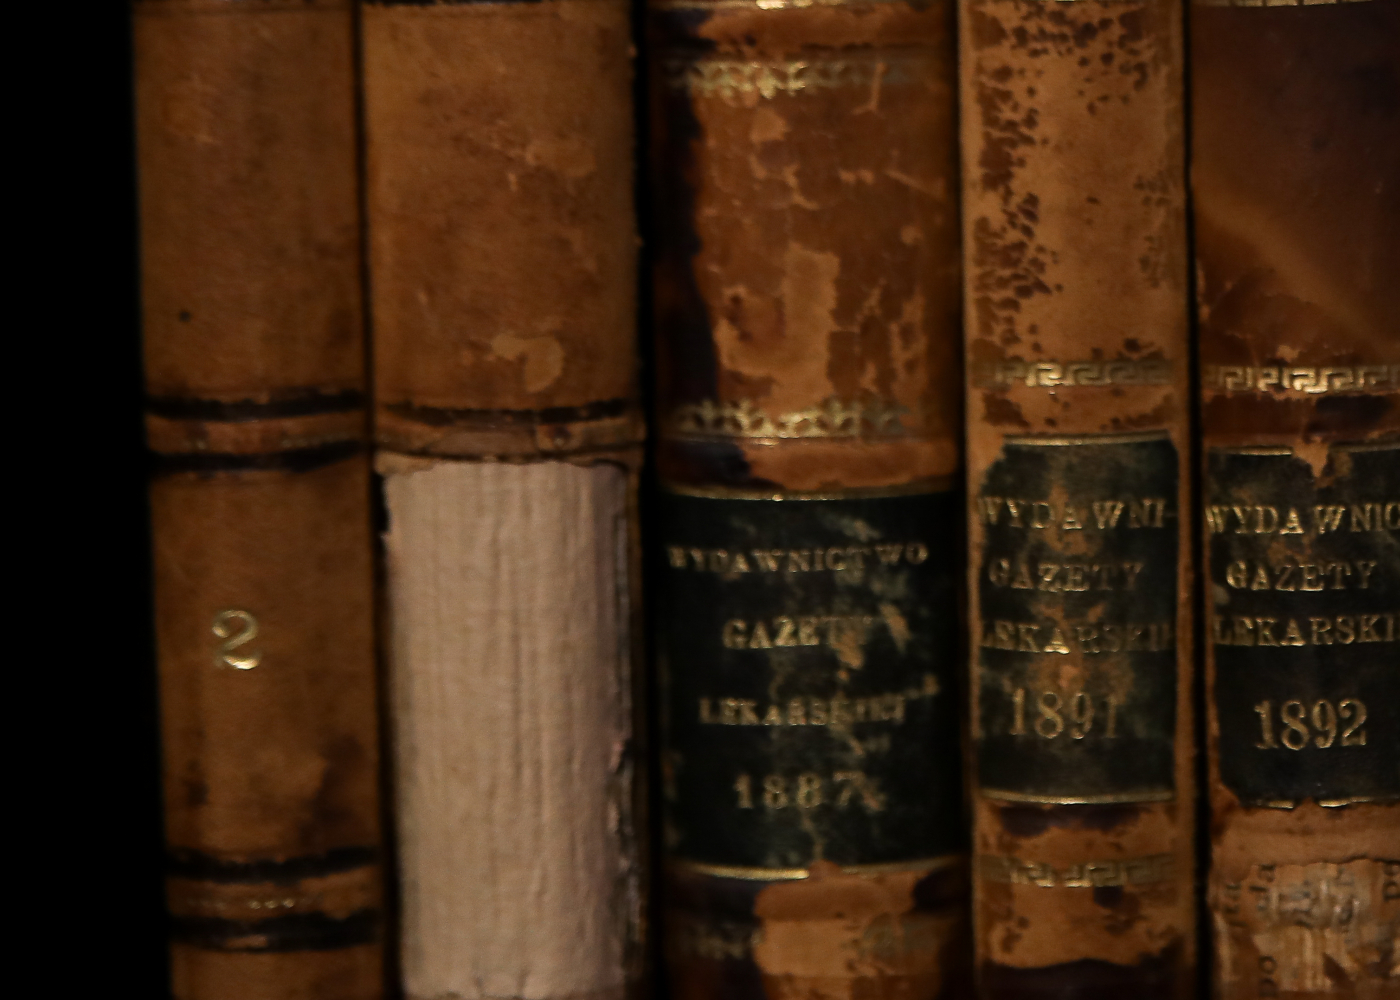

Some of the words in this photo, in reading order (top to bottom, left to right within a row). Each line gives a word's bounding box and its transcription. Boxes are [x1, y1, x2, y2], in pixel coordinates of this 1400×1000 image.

[988, 558, 1144, 592] GAZETY
[1226, 560, 1378, 592] GAZETY
[211, 608, 262, 669] 2
[1009, 688, 1118, 740] 1891
[1254, 699, 1369, 751] 1892
